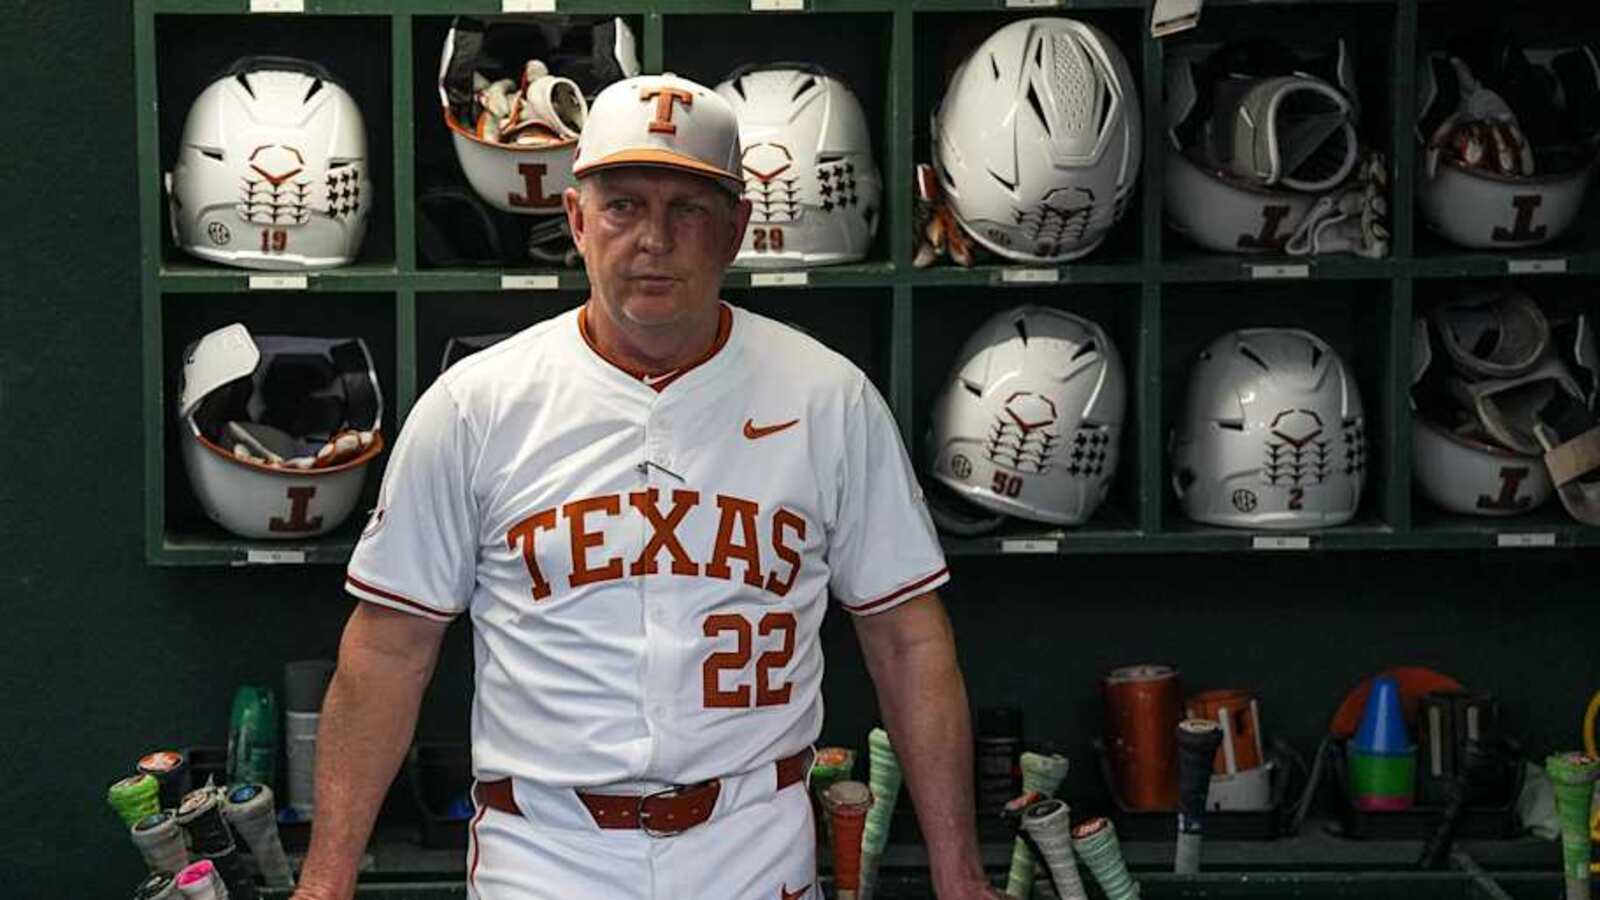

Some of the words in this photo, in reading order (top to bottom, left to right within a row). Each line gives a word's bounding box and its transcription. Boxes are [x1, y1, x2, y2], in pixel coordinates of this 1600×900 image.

[640, 88, 692, 135] T
[508, 164, 562, 209] T
[1237, 206, 1291, 248] T
[1492, 195, 1546, 240] T
[261, 229, 287, 252] 19
[753, 229, 784, 252] 29
[992, 471, 1022, 498] 50
[1290, 488, 1303, 510] 2
[1477, 467, 1531, 510] T
[269, 486, 321, 532] T
[506, 487, 807, 600] TEXAS
[703, 613, 796, 707] 22
